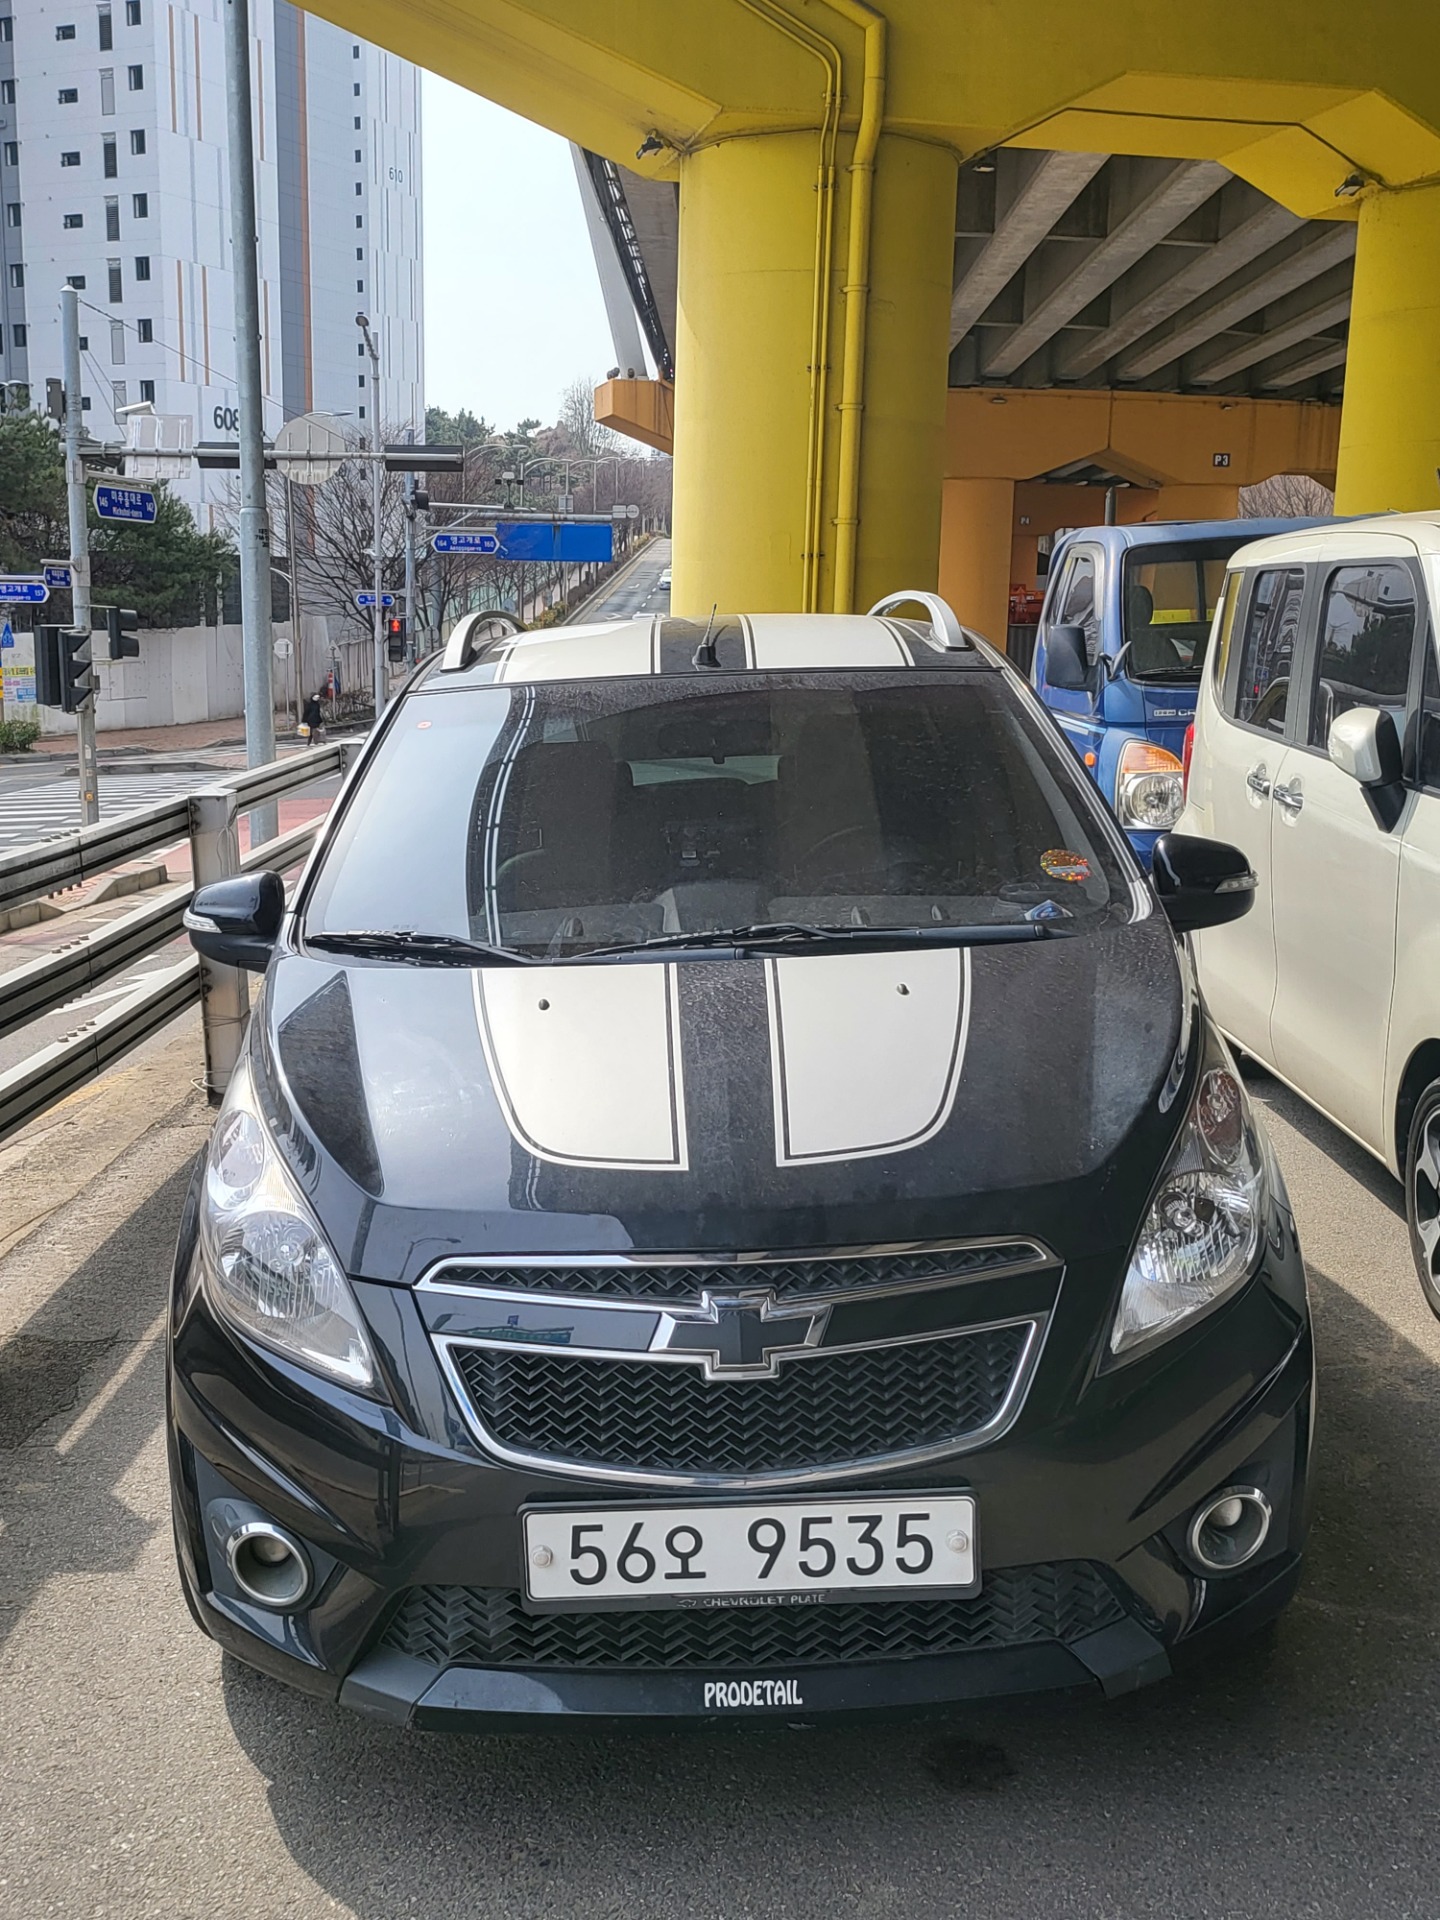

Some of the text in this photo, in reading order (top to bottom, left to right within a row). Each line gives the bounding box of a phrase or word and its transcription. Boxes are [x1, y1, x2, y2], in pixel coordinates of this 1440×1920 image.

[388, 166, 403, 183] 610
[1214, 455, 1229, 466] P3
[110, 490, 143, 508] 미추홀대로
[436, 539, 448, 547] 164
[484, 540, 495, 548] 160
[569, 1512, 934, 1586] 56오 9535
[703, 1593, 826, 1607] CHEVROLET PLATE
[704, 1679, 803, 1708] PRODETAIL
